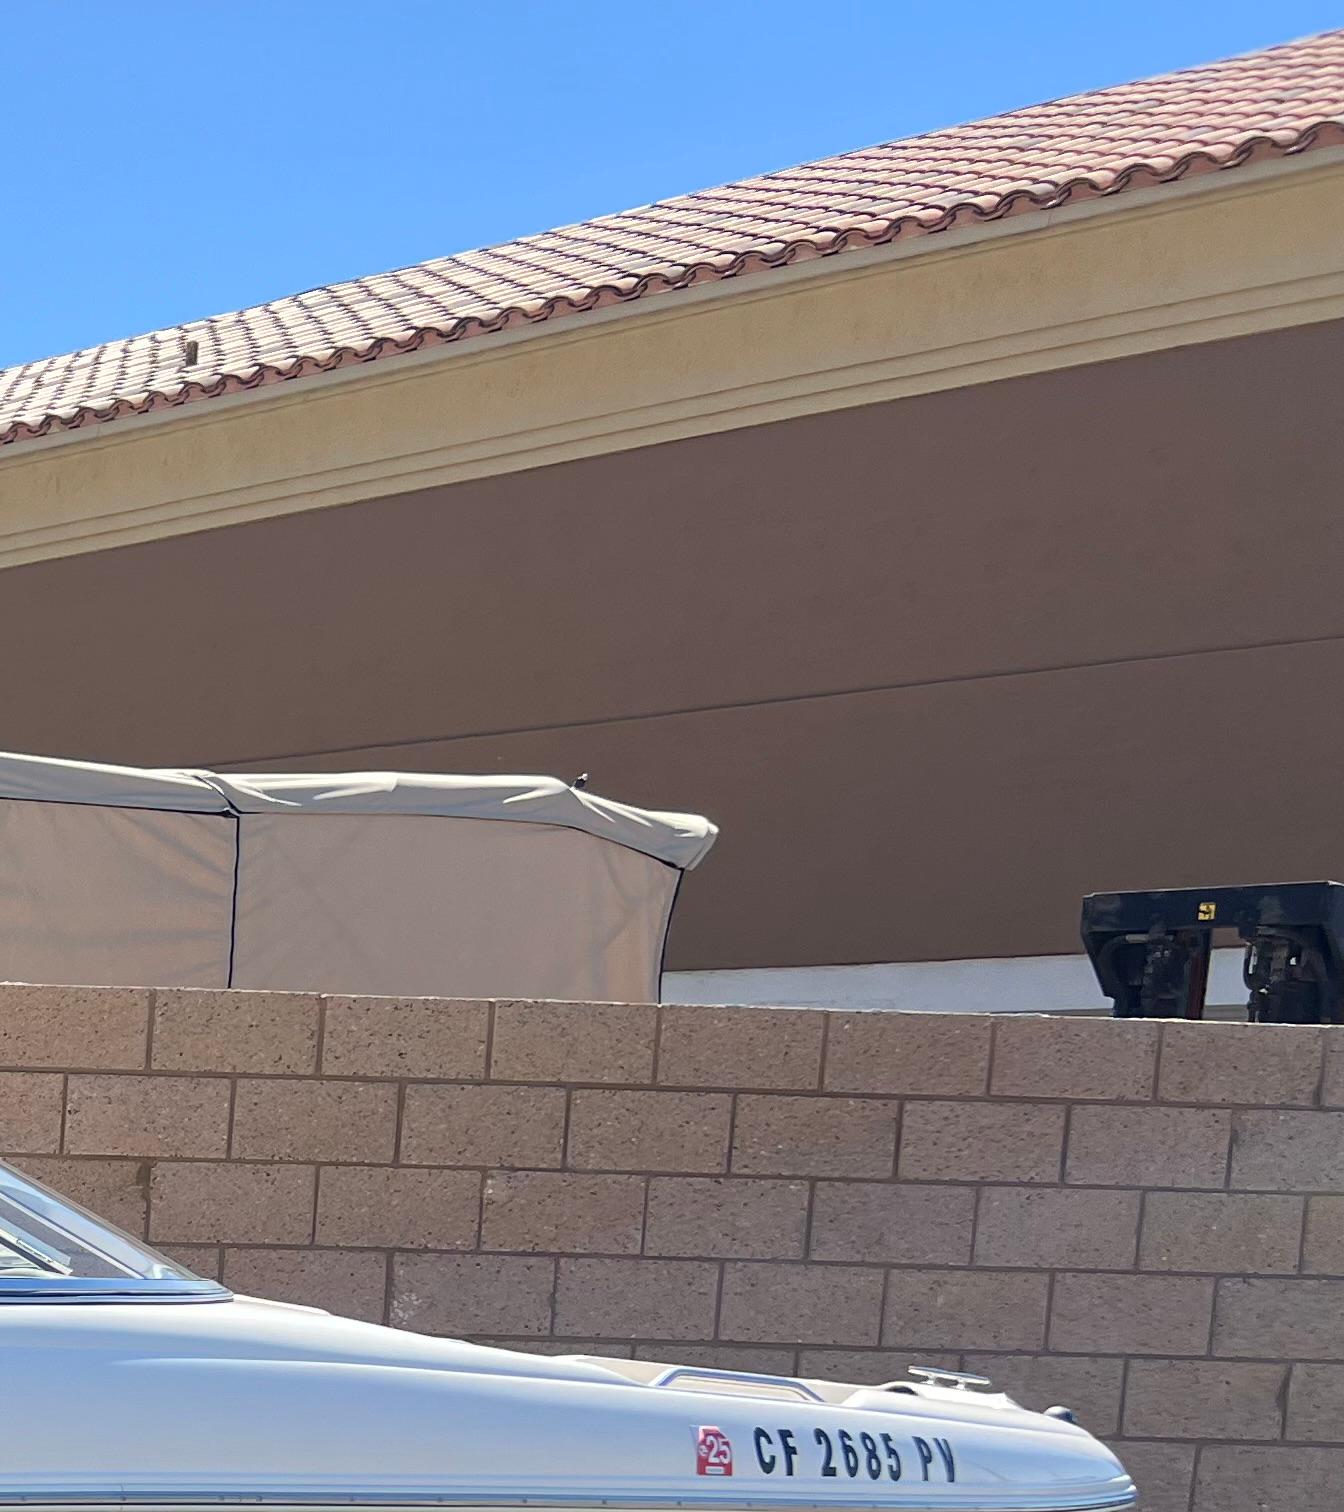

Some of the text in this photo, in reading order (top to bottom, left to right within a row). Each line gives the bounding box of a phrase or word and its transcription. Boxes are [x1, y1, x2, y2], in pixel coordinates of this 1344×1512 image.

[706, 1435, 731, 1464] 25
[753, 1426, 798, 1476] CF
[813, 1427, 901, 1482] 2685
